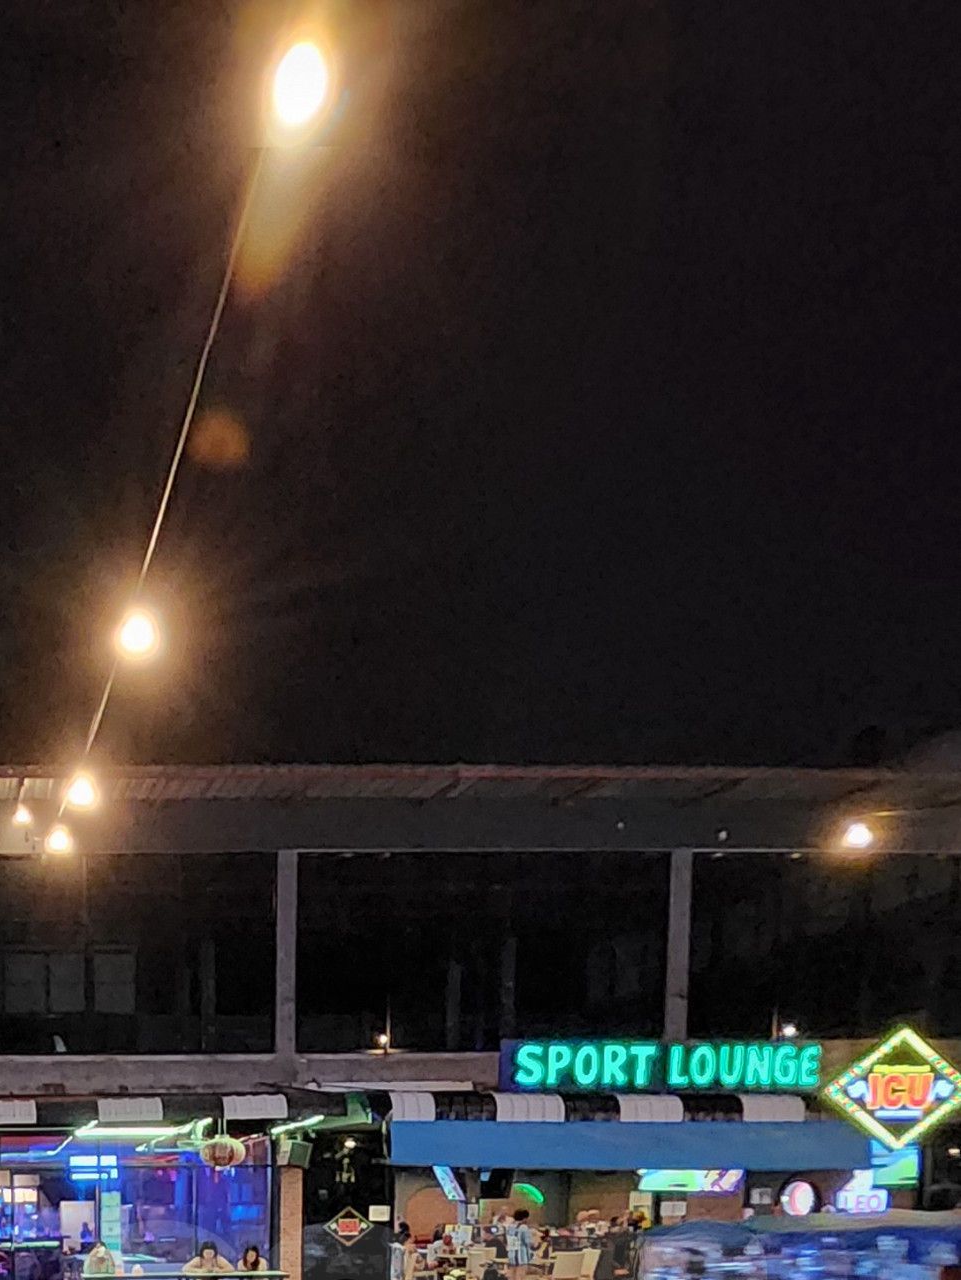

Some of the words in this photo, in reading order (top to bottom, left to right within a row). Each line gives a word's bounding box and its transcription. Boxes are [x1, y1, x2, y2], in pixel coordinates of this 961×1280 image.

[514, 1044, 657, 1086] SPORT
[667, 1044, 821, 1086] LOUNGE
[867, 1073, 934, 1109] ICU
[840, 1193, 882, 1213] LEO
